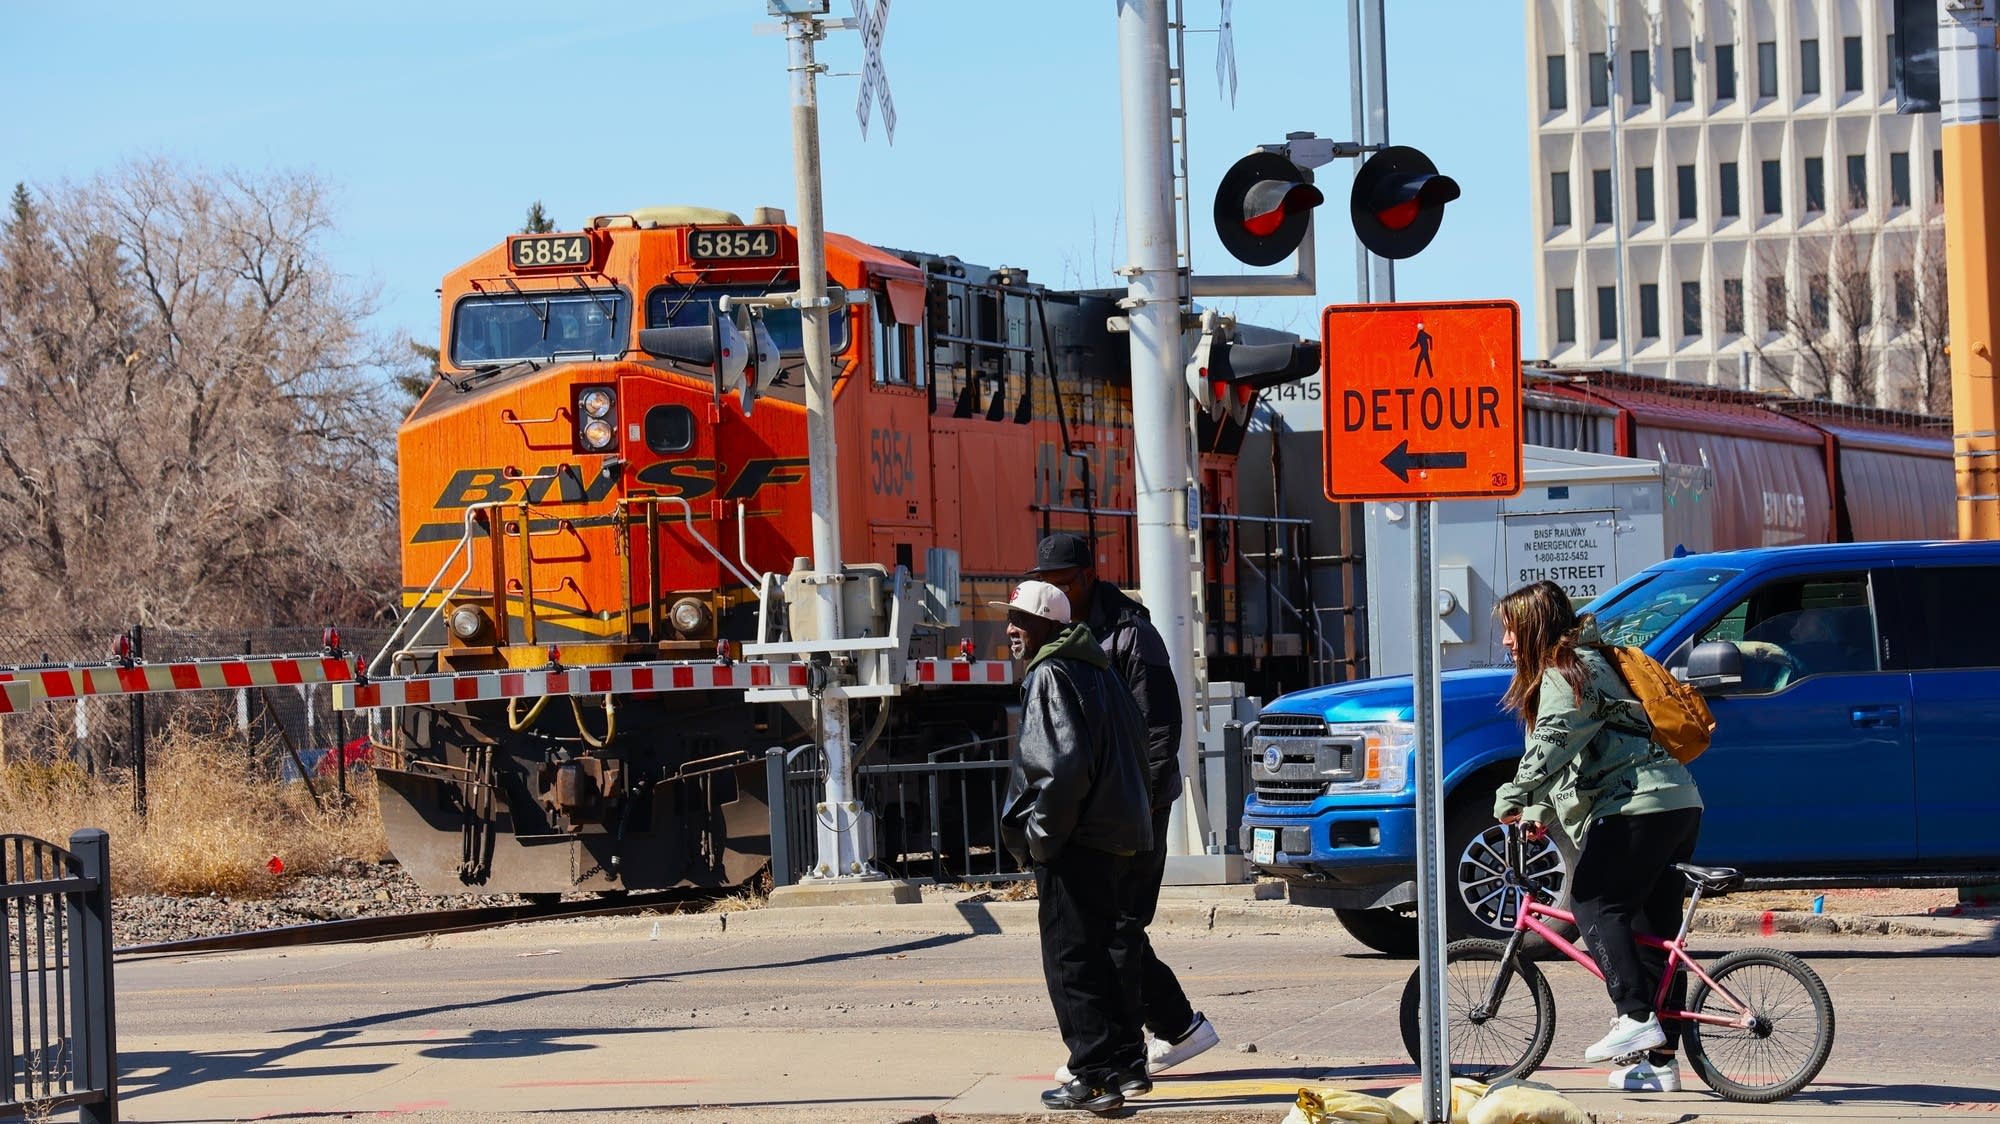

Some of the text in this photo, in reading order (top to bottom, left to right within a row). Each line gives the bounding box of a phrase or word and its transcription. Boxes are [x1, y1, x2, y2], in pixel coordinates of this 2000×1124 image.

[519, 237, 590, 265] 5854
[696, 231, 770, 258] 5854
[1261, 382, 1321, 402] 21415
[1344, 386, 1500, 432] DETOUR
[869, 428, 915, 497] 5854
[434, 457, 811, 510] BNSF
[1762, 490, 1806, 529] BNSF
[1524, 539, 1598, 551] IN EMERGENCY CALL
[1534, 527, 1587, 539] BNSF RAILWAY
[1534, 551, 1589, 562] 1-800-832-5452
[1520, 565, 1605, 582] 8TH STREET
[1595, 938, 1620, 989] Reebok
